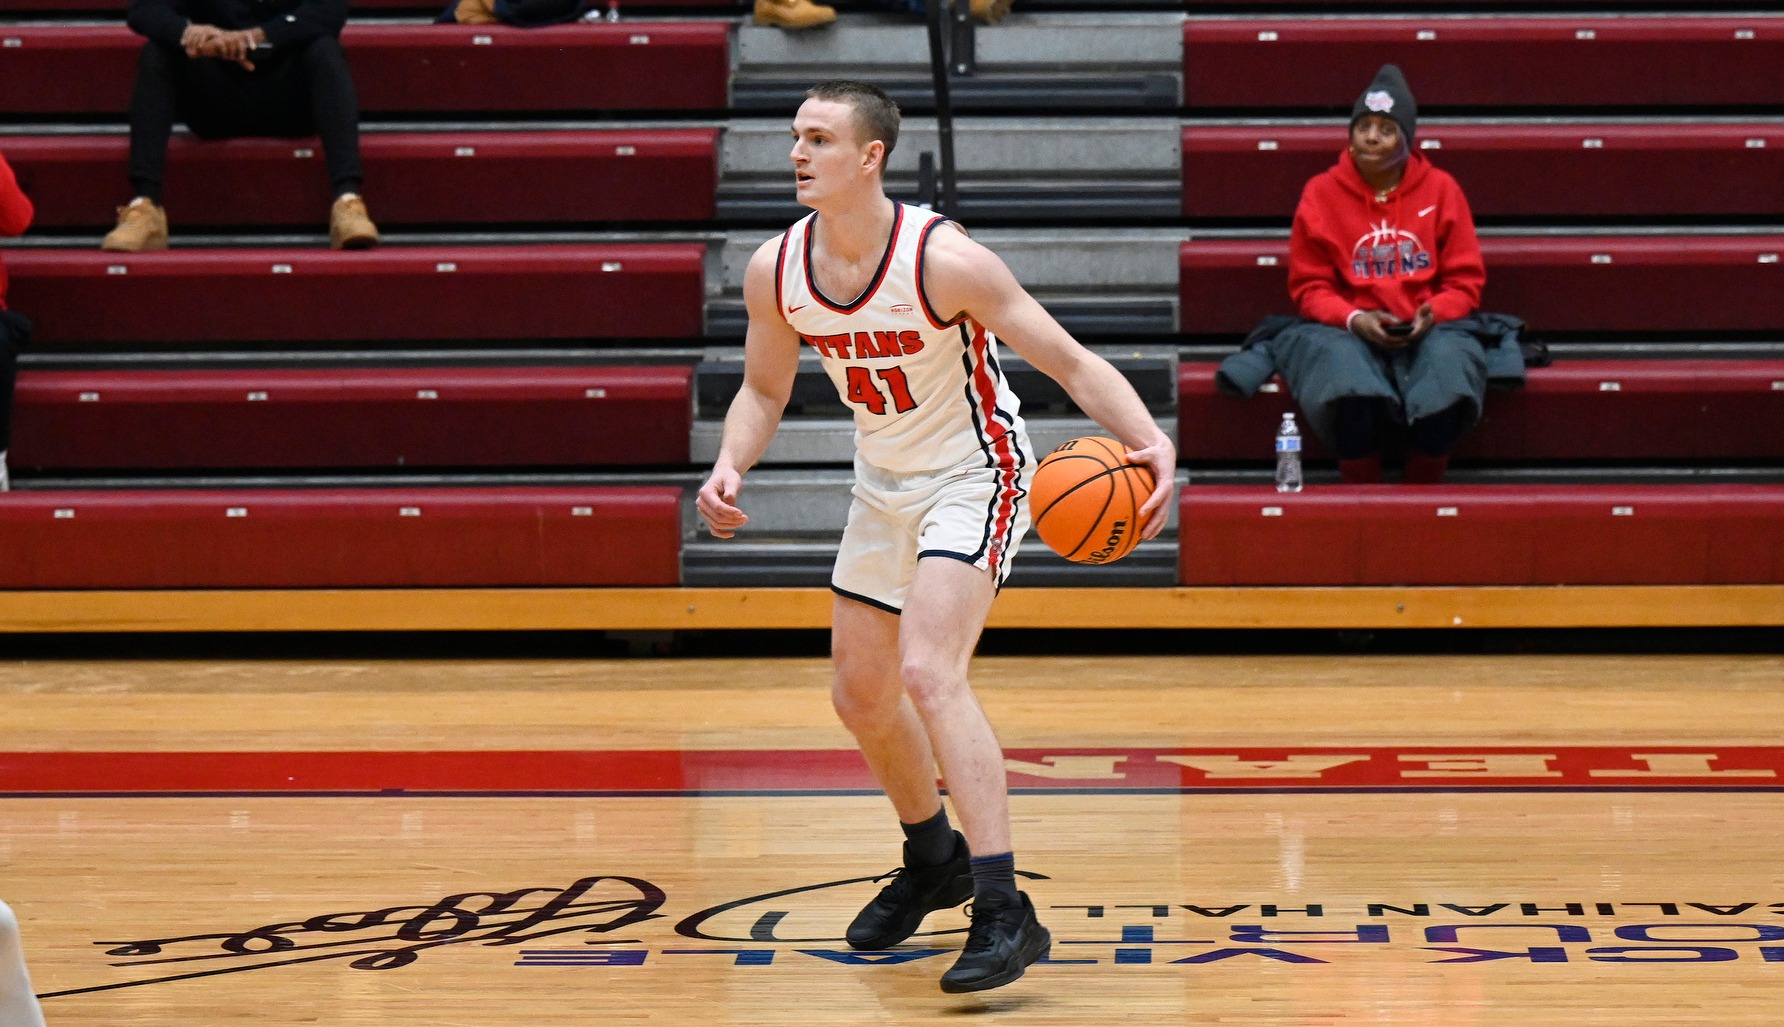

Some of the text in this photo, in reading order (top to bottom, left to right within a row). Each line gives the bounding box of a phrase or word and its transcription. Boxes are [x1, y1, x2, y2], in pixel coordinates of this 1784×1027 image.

[846, 365, 918, 415] 41
[1084, 521, 1127, 564] ilson
[1050, 902, 1784, 918] ALIHAN HALL
